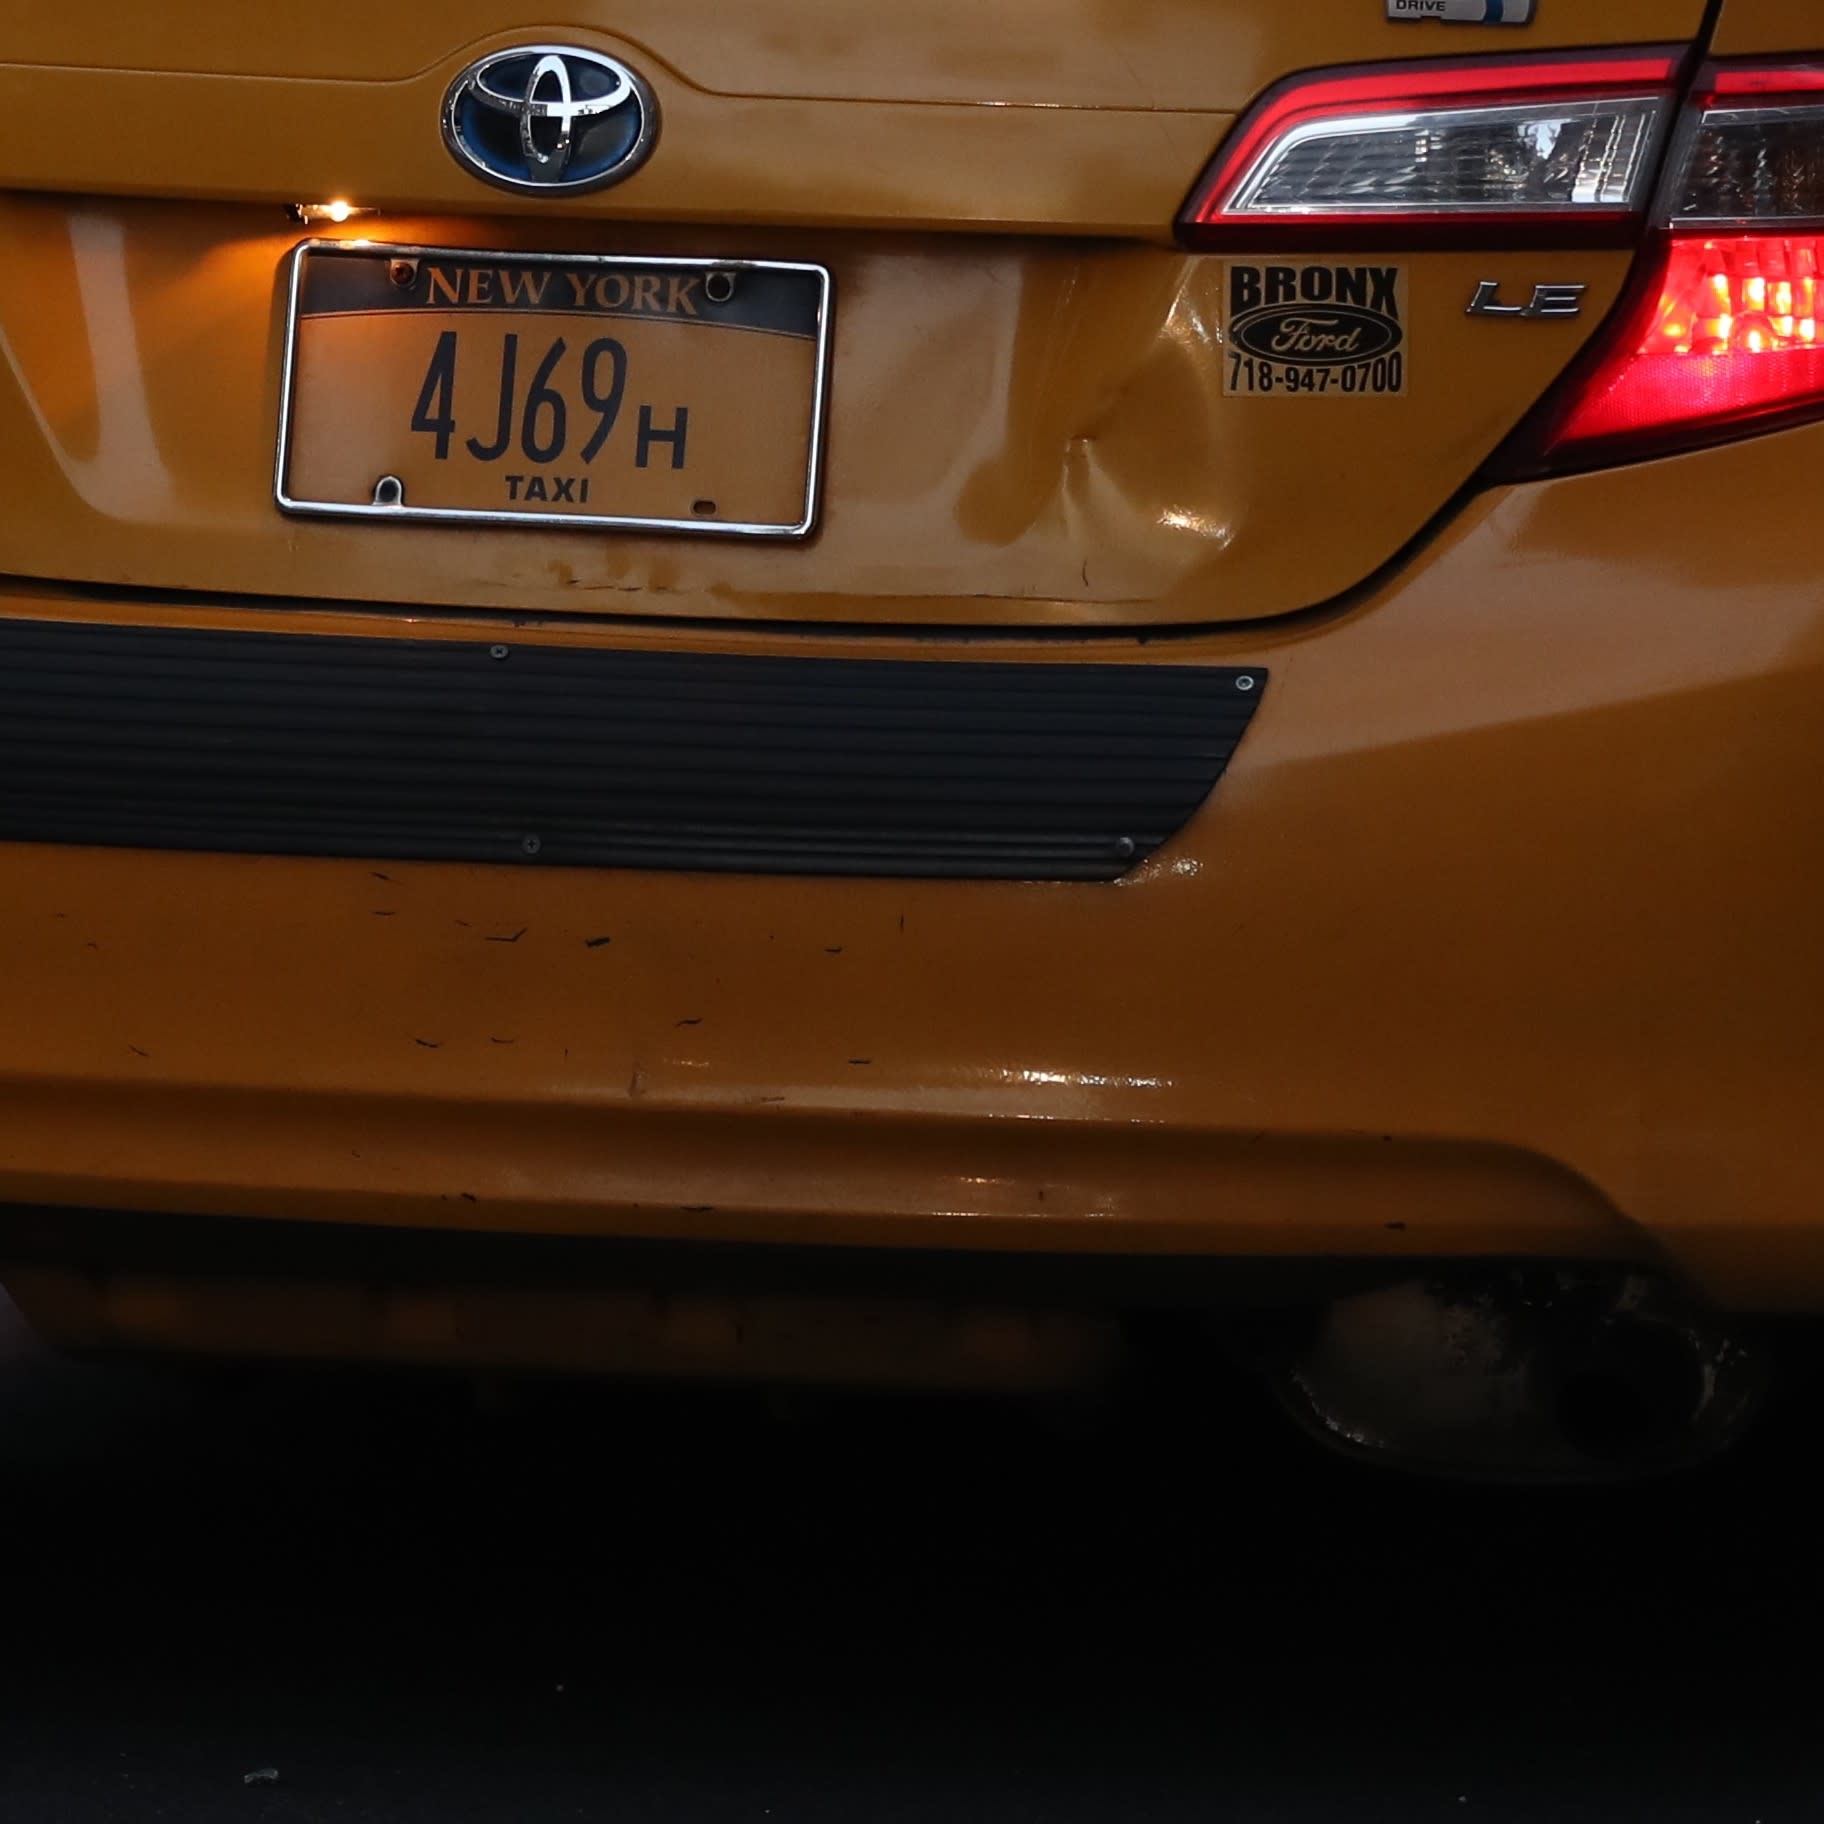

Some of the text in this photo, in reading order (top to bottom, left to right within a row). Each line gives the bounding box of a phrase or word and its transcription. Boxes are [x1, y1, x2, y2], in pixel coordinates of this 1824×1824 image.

[1396, 0, 1446, 11] DRIVE
[426, 266, 702, 316] NEW YORK
[1230, 266, 1399, 320] BRONX
[1465, 281, 1586, 317] LE
[1271, 317, 1360, 353] Ford
[1228, 351, 1403, 392] 718-947-0700
[505, 475, 589, 504] TAXI
